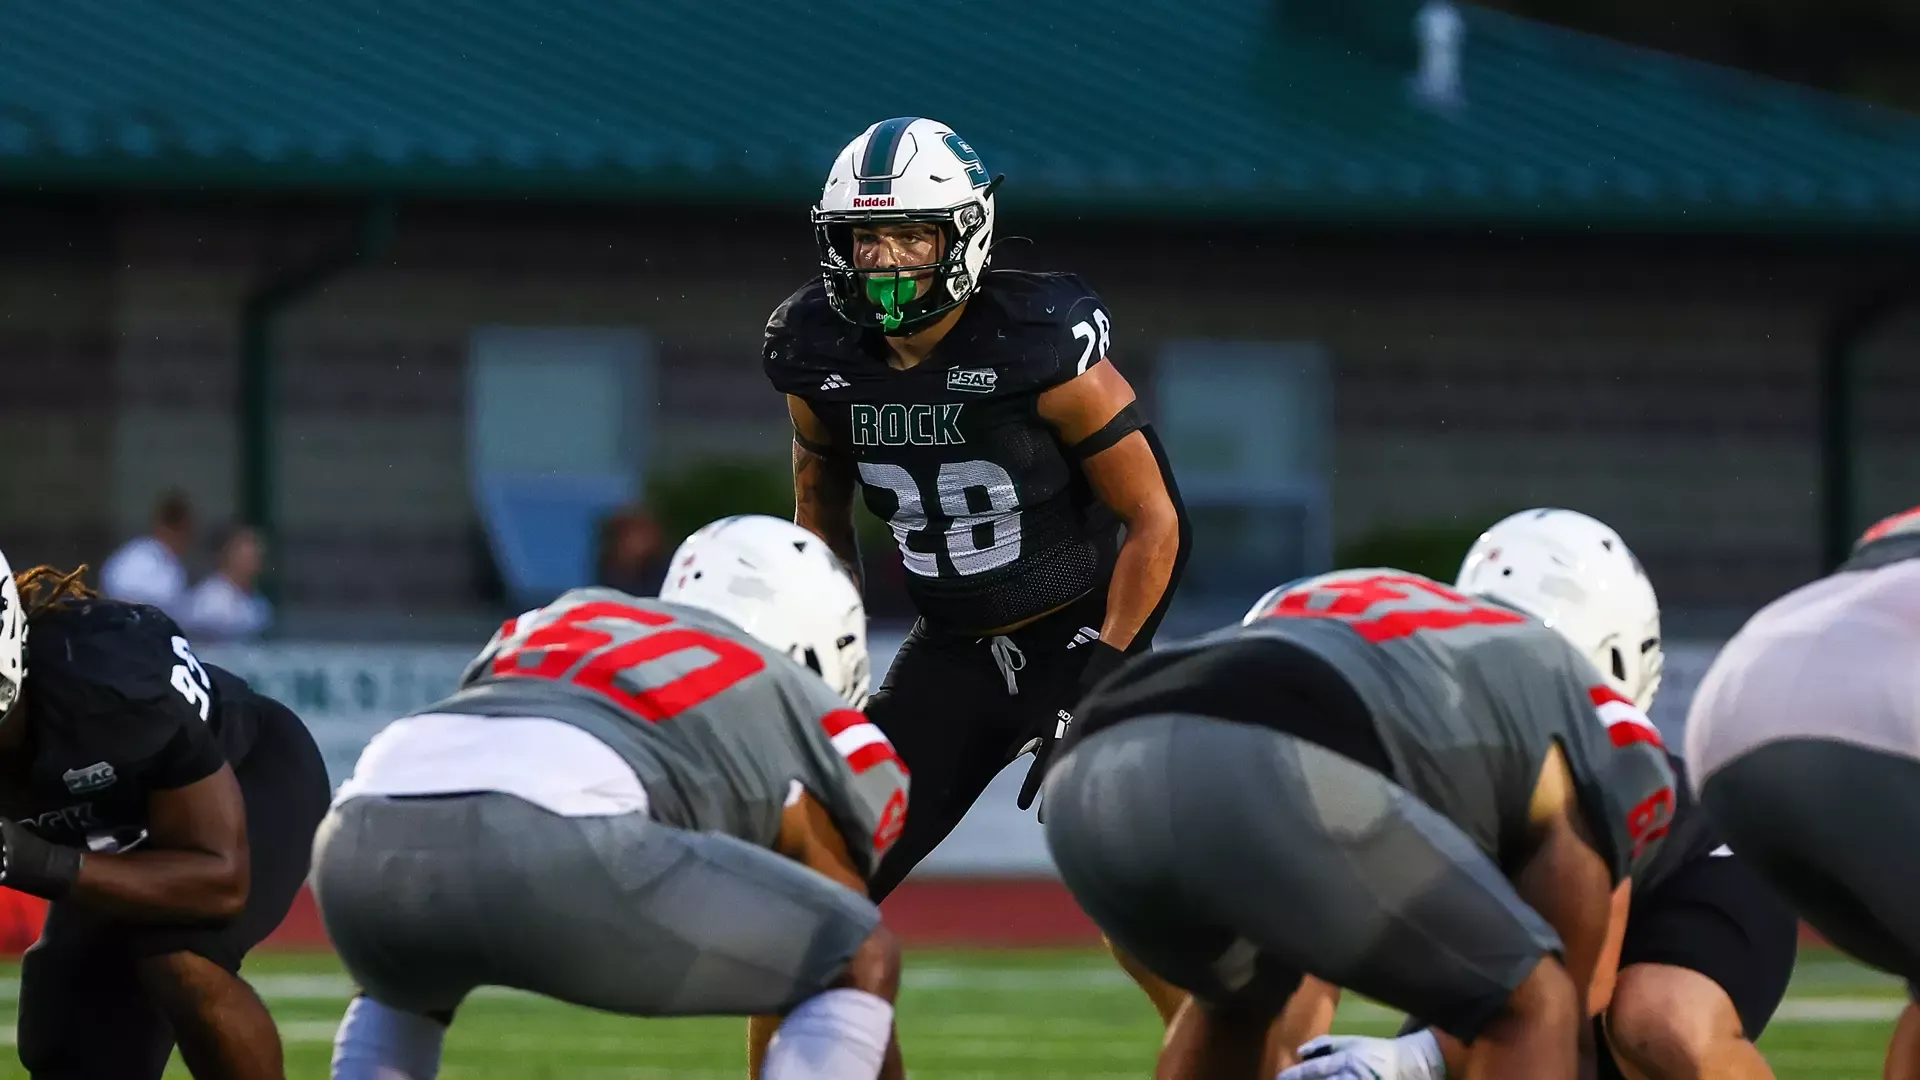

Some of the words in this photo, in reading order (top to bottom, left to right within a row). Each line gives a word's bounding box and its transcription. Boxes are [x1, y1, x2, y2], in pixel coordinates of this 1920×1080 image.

[853, 197, 895, 208] Riddell
[828, 246, 854, 277] Riddl
[948, 371, 995, 387] PSAC
[851, 403, 966, 446] ROCK
[857, 459, 1023, 577] 28
[492, 601, 767, 724] 60
